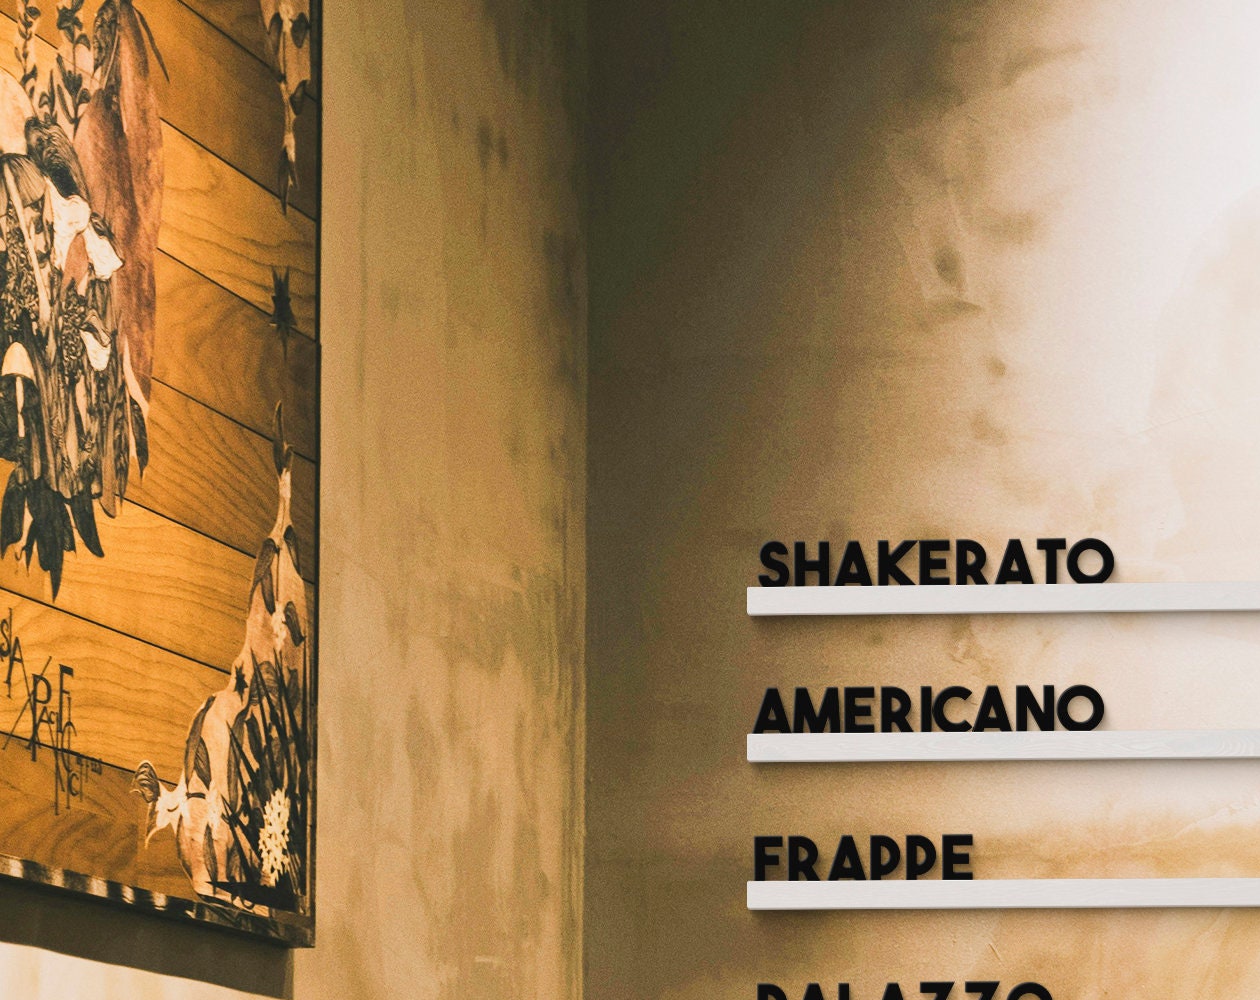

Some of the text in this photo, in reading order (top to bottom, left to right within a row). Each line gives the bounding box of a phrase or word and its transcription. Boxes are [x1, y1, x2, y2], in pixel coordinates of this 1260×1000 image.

[758, 538, 1115, 587] SHAKERATO
[752, 685, 1105, 733] AMERICANO
[754, 834, 974, 881] FRAPPE
